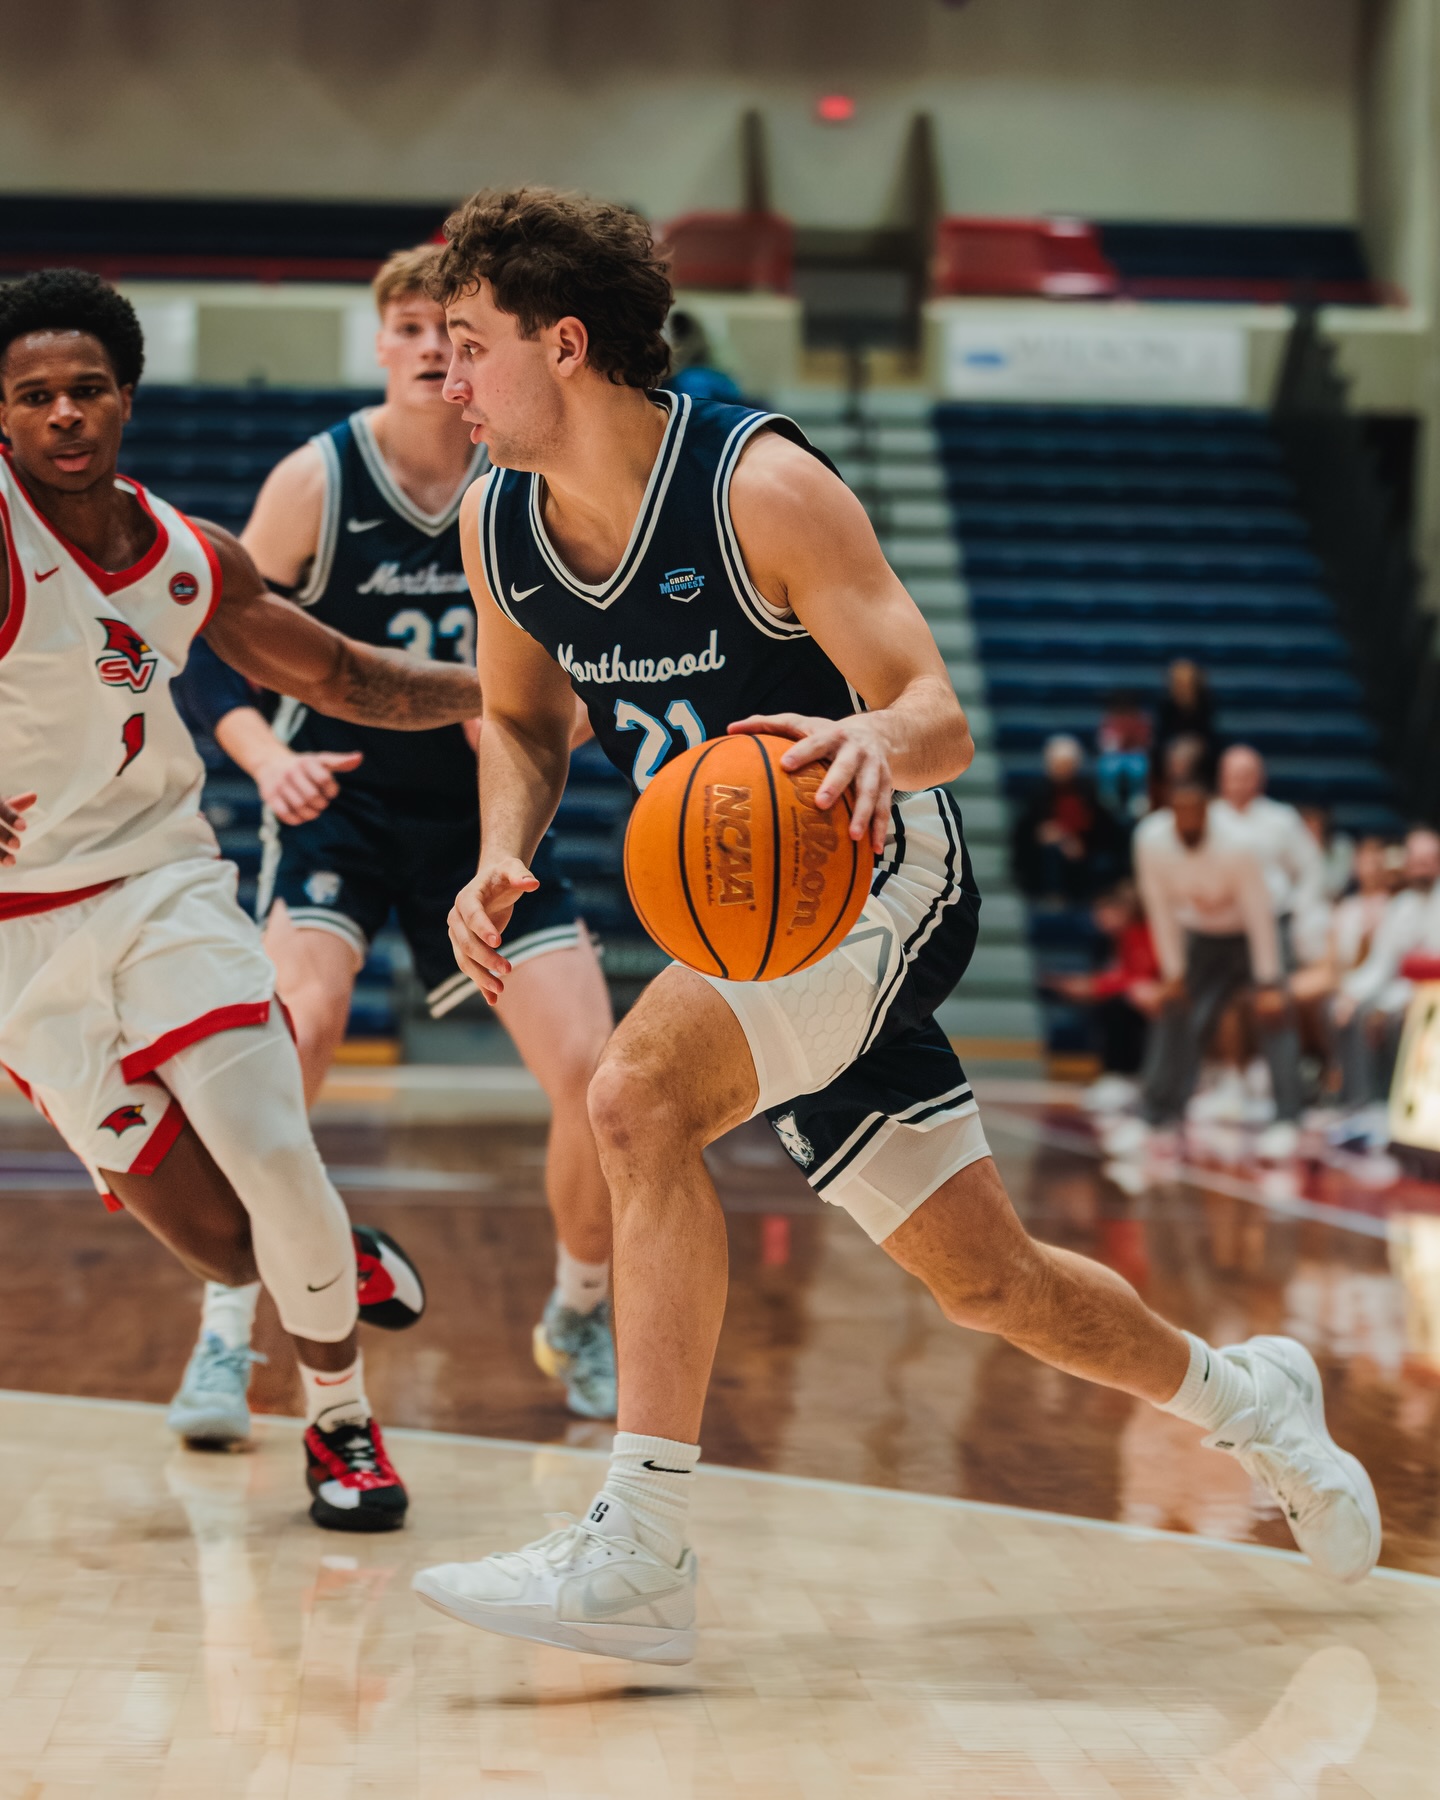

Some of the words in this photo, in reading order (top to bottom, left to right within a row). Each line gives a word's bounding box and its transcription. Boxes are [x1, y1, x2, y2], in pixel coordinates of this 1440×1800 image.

[659, 575, 705, 595] MIDWEST
[669, 574, 695, 585] GREAT
[95, 655, 158, 693] SV
[713, 784, 755, 906] NCAA
